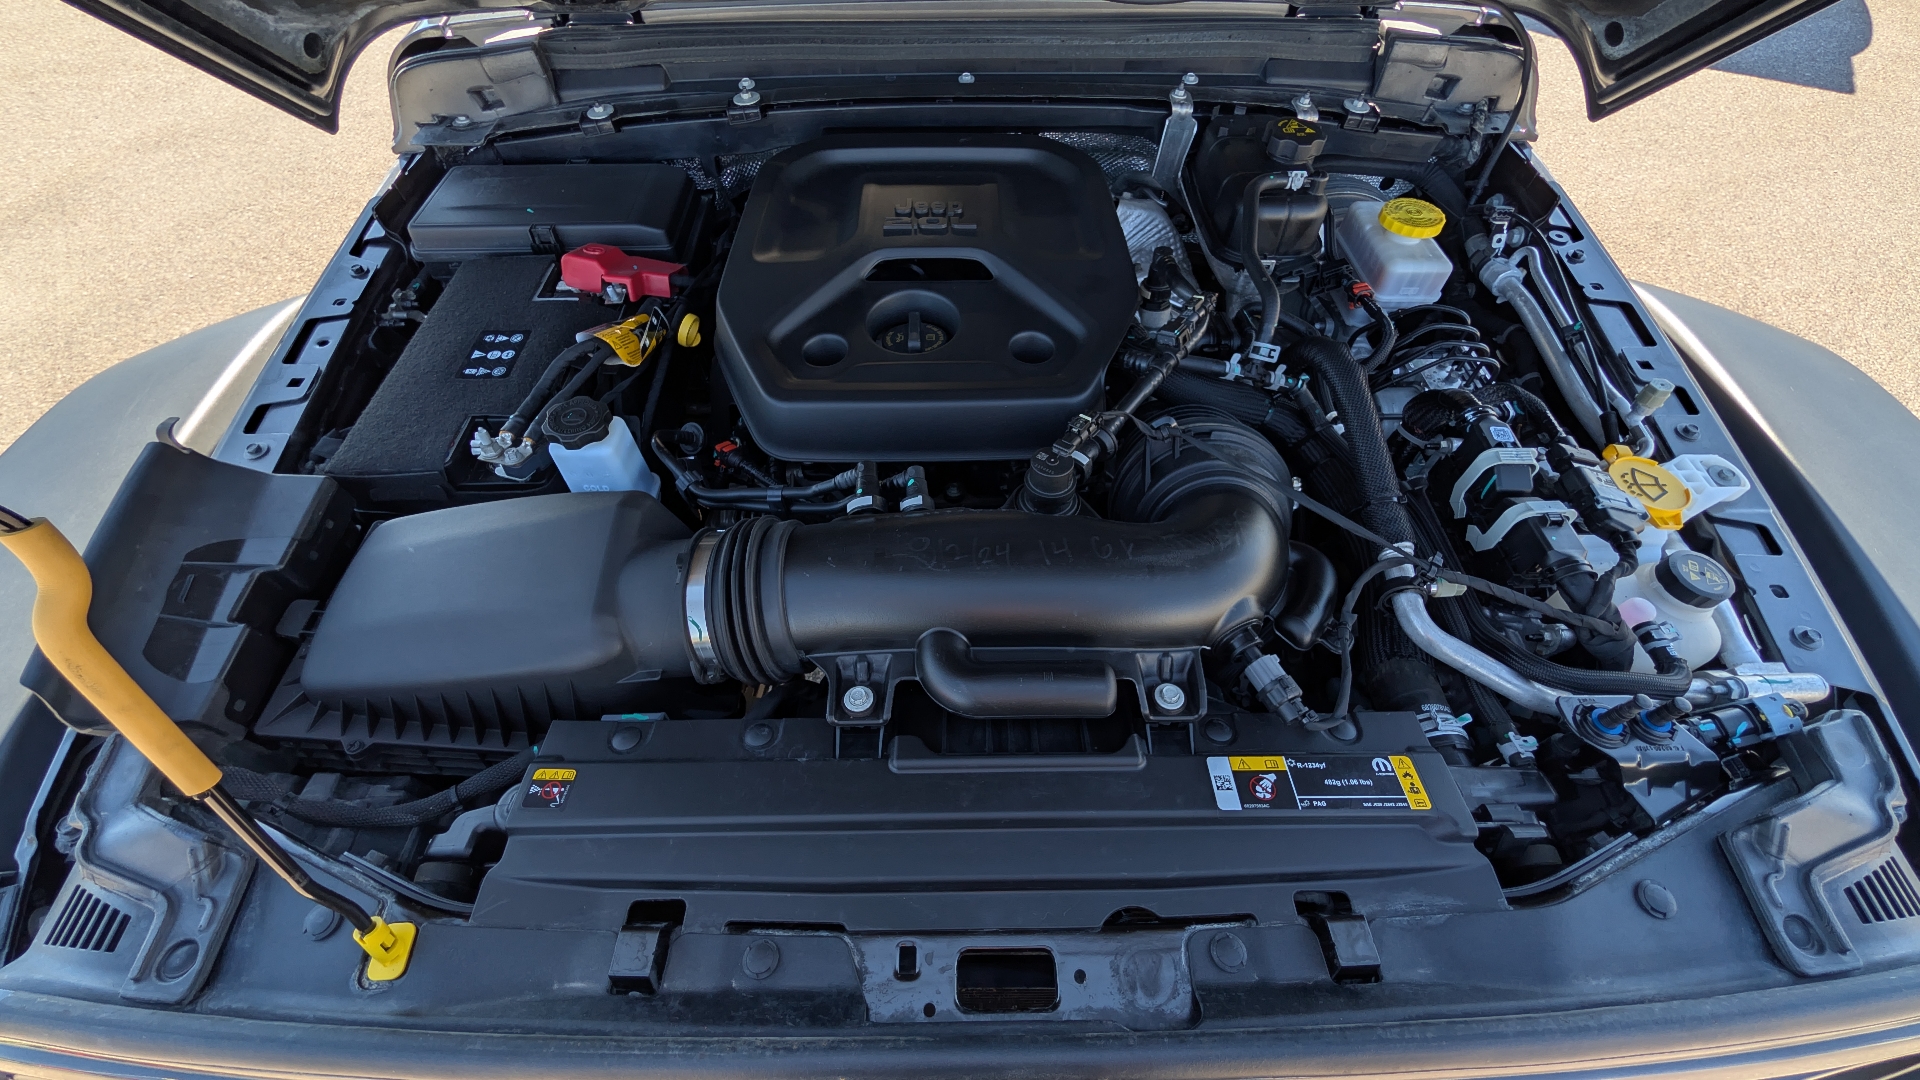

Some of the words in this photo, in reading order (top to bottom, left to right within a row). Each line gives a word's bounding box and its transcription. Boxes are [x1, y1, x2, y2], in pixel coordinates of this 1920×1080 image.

[894, 198, 964, 218] Jeep
[583, 484, 610, 492] COLD
[1296, 762, 1326, 770] R-1234yf
